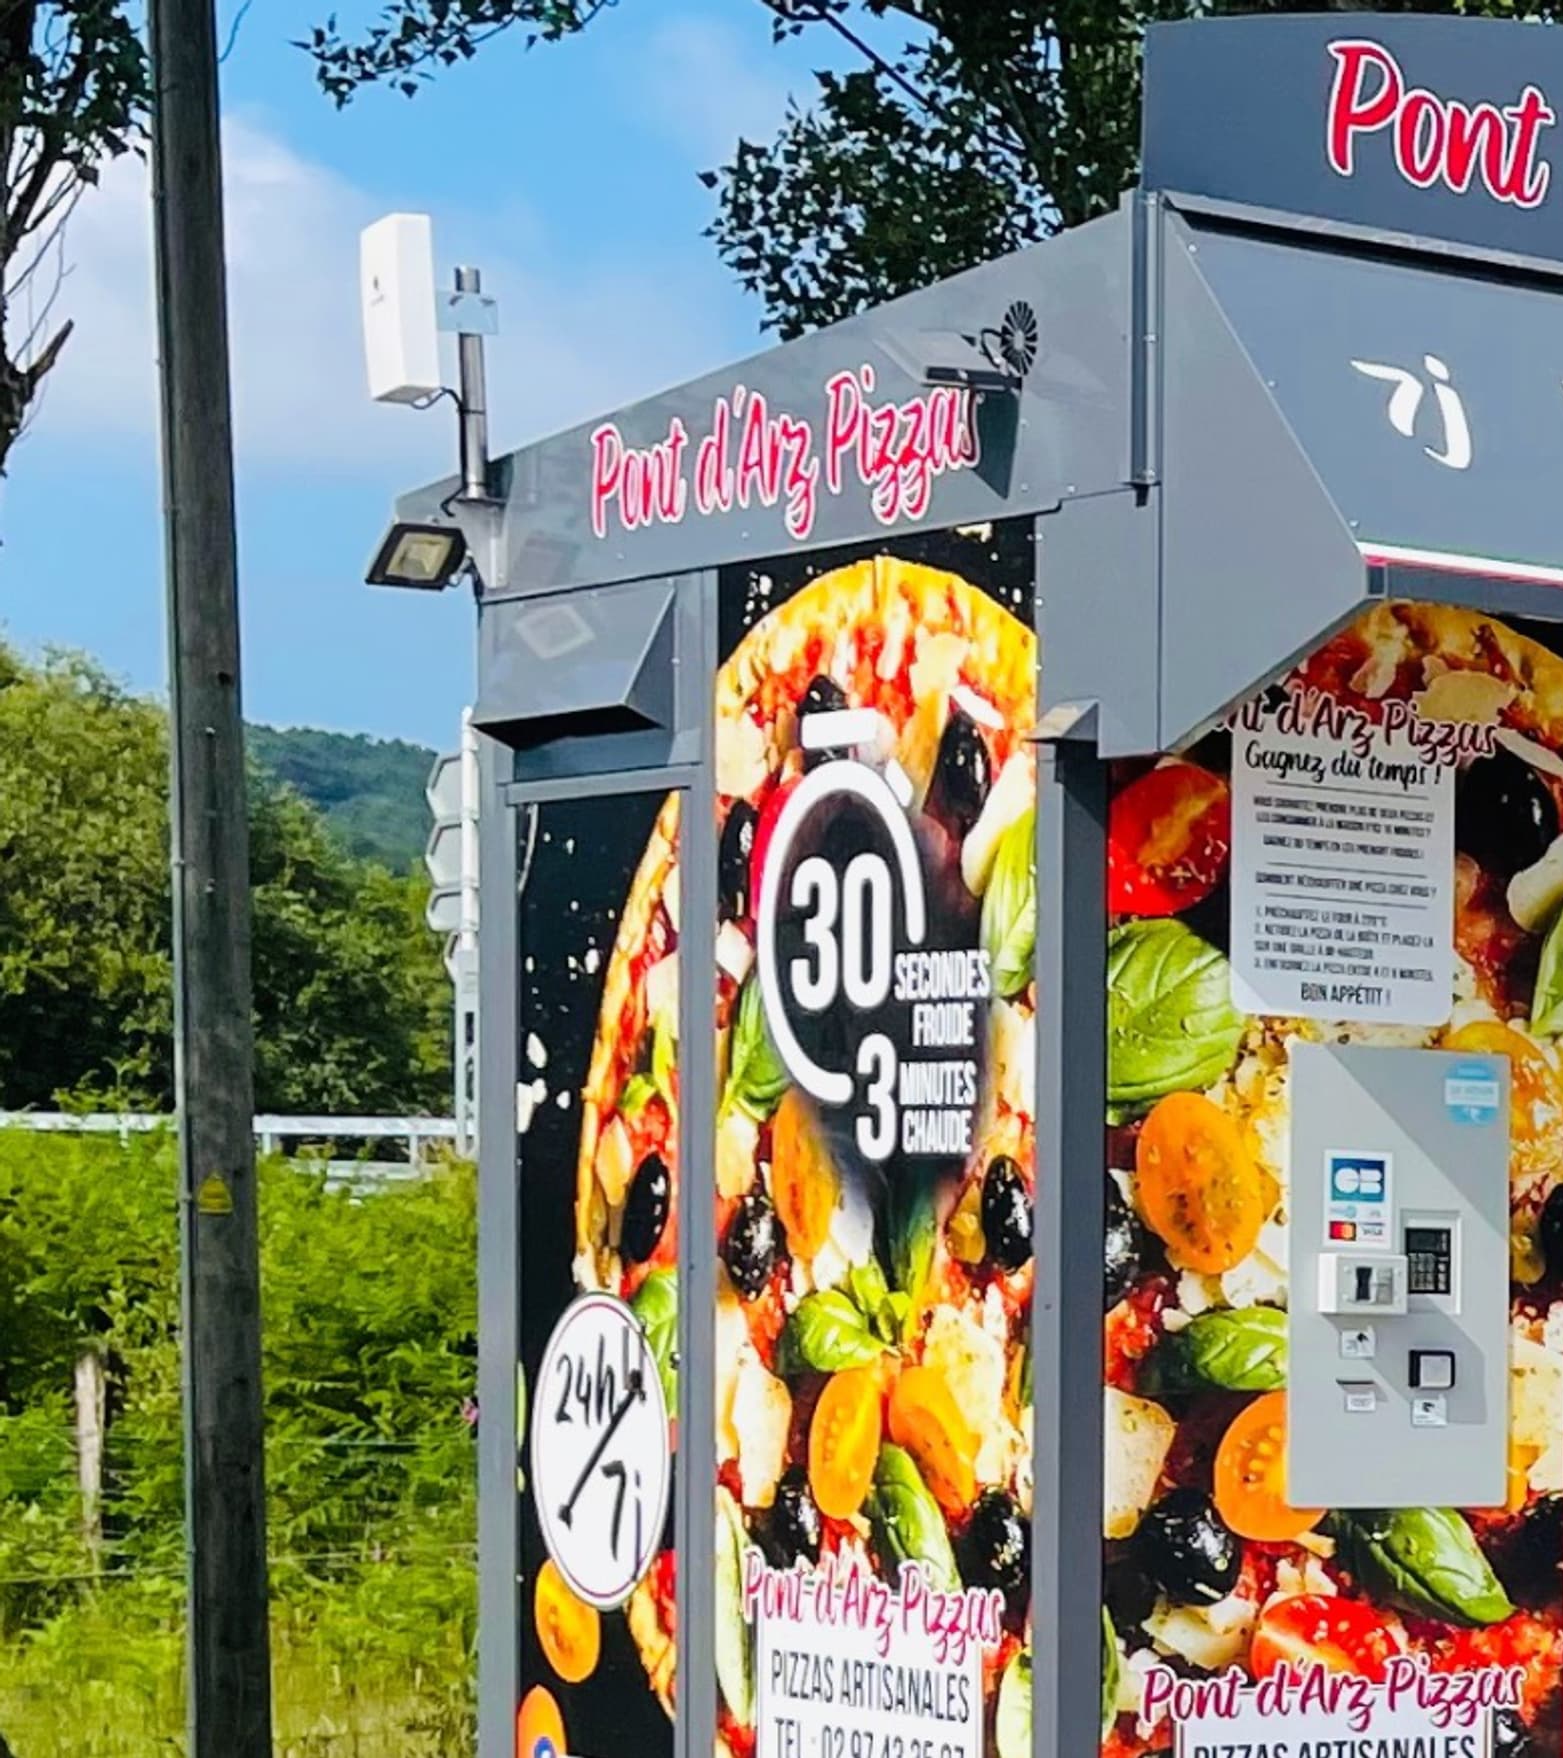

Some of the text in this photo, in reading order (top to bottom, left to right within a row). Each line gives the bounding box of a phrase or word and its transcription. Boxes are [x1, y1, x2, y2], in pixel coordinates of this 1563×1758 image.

[1327, 38, 1555, 208] Pont
[1350, 354, 1471, 469] 7j
[590, 364, 981, 539] Pont d'Arz Pizzas
[1245, 739, 1327, 783] Gagnez
[1331, 750, 1361, 778] du
[1369, 756, 1426, 790] temps
[1382, 698, 1498, 765] Pizzas
[791, 852, 990, 1011] 30 SECONDES
[912, 1003, 974, 1046] FROIDE
[1301, 982, 1327, 1002] BON
[1331, 982, 1383, 1005] APPÉTIT
[856, 1032, 976, 1160] 3 MINUTES
[902, 1111, 972, 1154] CHAUDE
[744, 1548, 805, 1623] Pont
[900, 1561, 1004, 1667] Pizzas
[771, 1649, 970, 1724] PIZZAS ARTISANALES
[1141, 1655, 1525, 1732] Pont d'Arz Pizzas
